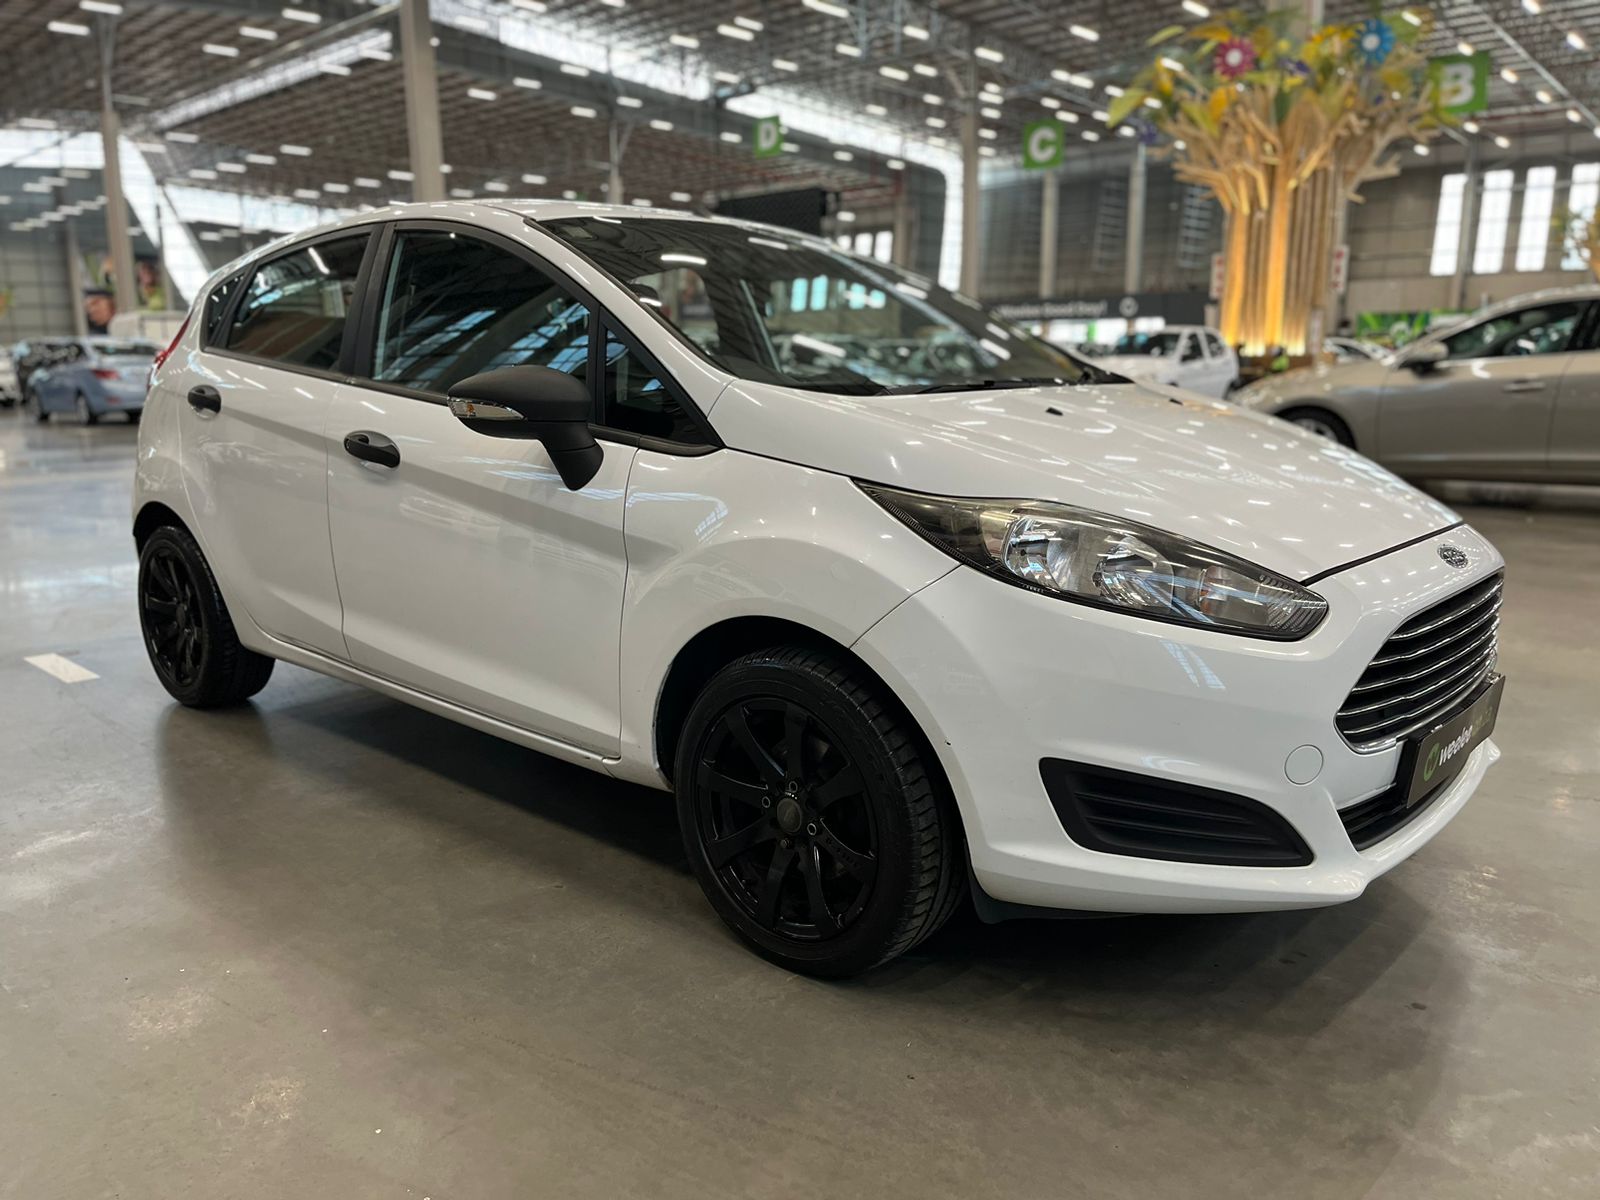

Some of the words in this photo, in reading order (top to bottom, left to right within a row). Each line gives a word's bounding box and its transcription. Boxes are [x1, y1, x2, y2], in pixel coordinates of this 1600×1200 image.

[1441, 63, 1475, 108] B
[759, 121, 778, 150] D
[1028, 126, 1057, 162] C
